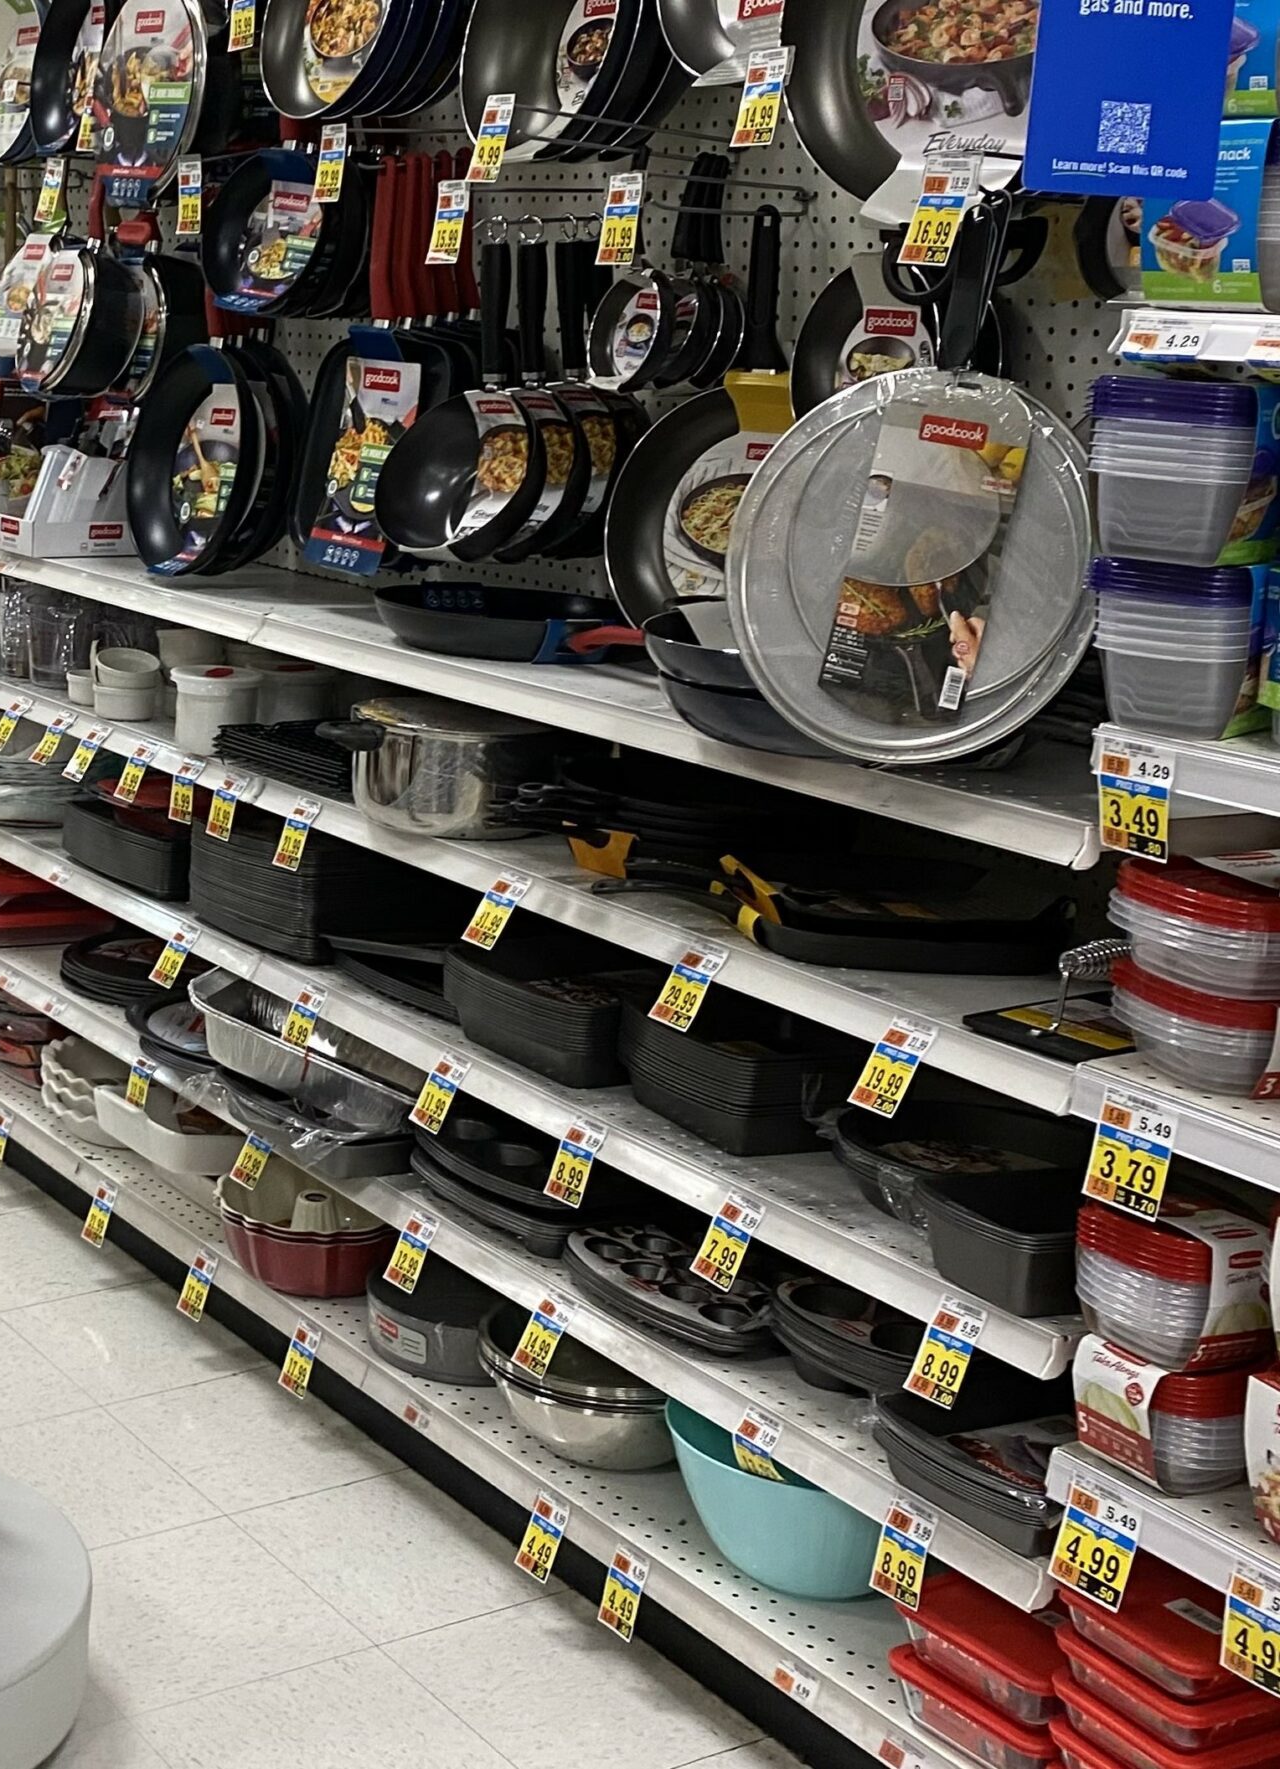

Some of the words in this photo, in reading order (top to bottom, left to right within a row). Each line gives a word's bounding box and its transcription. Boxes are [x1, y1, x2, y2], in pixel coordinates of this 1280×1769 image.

[1114, 0, 1143, 15] and
[1148, 2, 1194, 19] more.
[742, 105, 774, 129] 14.99
[923, 131, 1006, 152] Everyday
[477, 146, 501, 166] 9.99
[1218, 147, 1252, 160] nack
[1052, 158, 1078, 170] Learn
[1080, 160, 1106, 172] more!
[1108, 162, 1130, 175] Scan
[1132, 164, 1149, 176] this
[1151, 166, 1164, 177] QR
[1166, 167, 1188, 179] code
[435, 229, 458, 249] 15.99
[605, 227, 632, 247] 21.99
[913, 220, 951, 245] 16.99
[926, 250, 946, 262] 2.00
[868, 313, 916, 331] goodcook
[1166, 335, 1200, 348] 4.29
[921, 420, 985, 442] goodcook
[1138, 762, 1170, 780] 4.29
[1109, 799, 1159, 838] 3.49
[663, 985, 698, 1013] 29.99
[287, 1020, 309, 1043] 8.99
[865, 1066, 904, 1097] 19.99
[1259, 1077, 1277, 1095] 3
[1139, 1116, 1172, 1139] 5.49
[556, 1162, 583, 1189] 8.99
[1100, 1150, 1157, 1195] 3.79
[1128, 1195, 1156, 1215] 1.70
[706, 1239, 738, 1271] 7.99
[960, 1321, 980, 1337] 9.99
[524, 1330, 551, 1361] 14.99
[1191, 1344, 1207, 1362] 5
[922, 1353, 959, 1387] 8.99
[931, 1388, 952, 1406] 1.00
[1078, 1411, 1088, 1432] 5
[1106, 1506, 1137, 1531] 5.49
[526, 1535, 552, 1564] 4.49
[1066, 1535, 1121, 1583] 4.99
[881, 1552, 916, 1588] 8.99
[608, 1589, 634, 1621] 4.49
[1094, 1586, 1115, 1602] .50
[1234, 1627, 1280, 1675] 4.9
